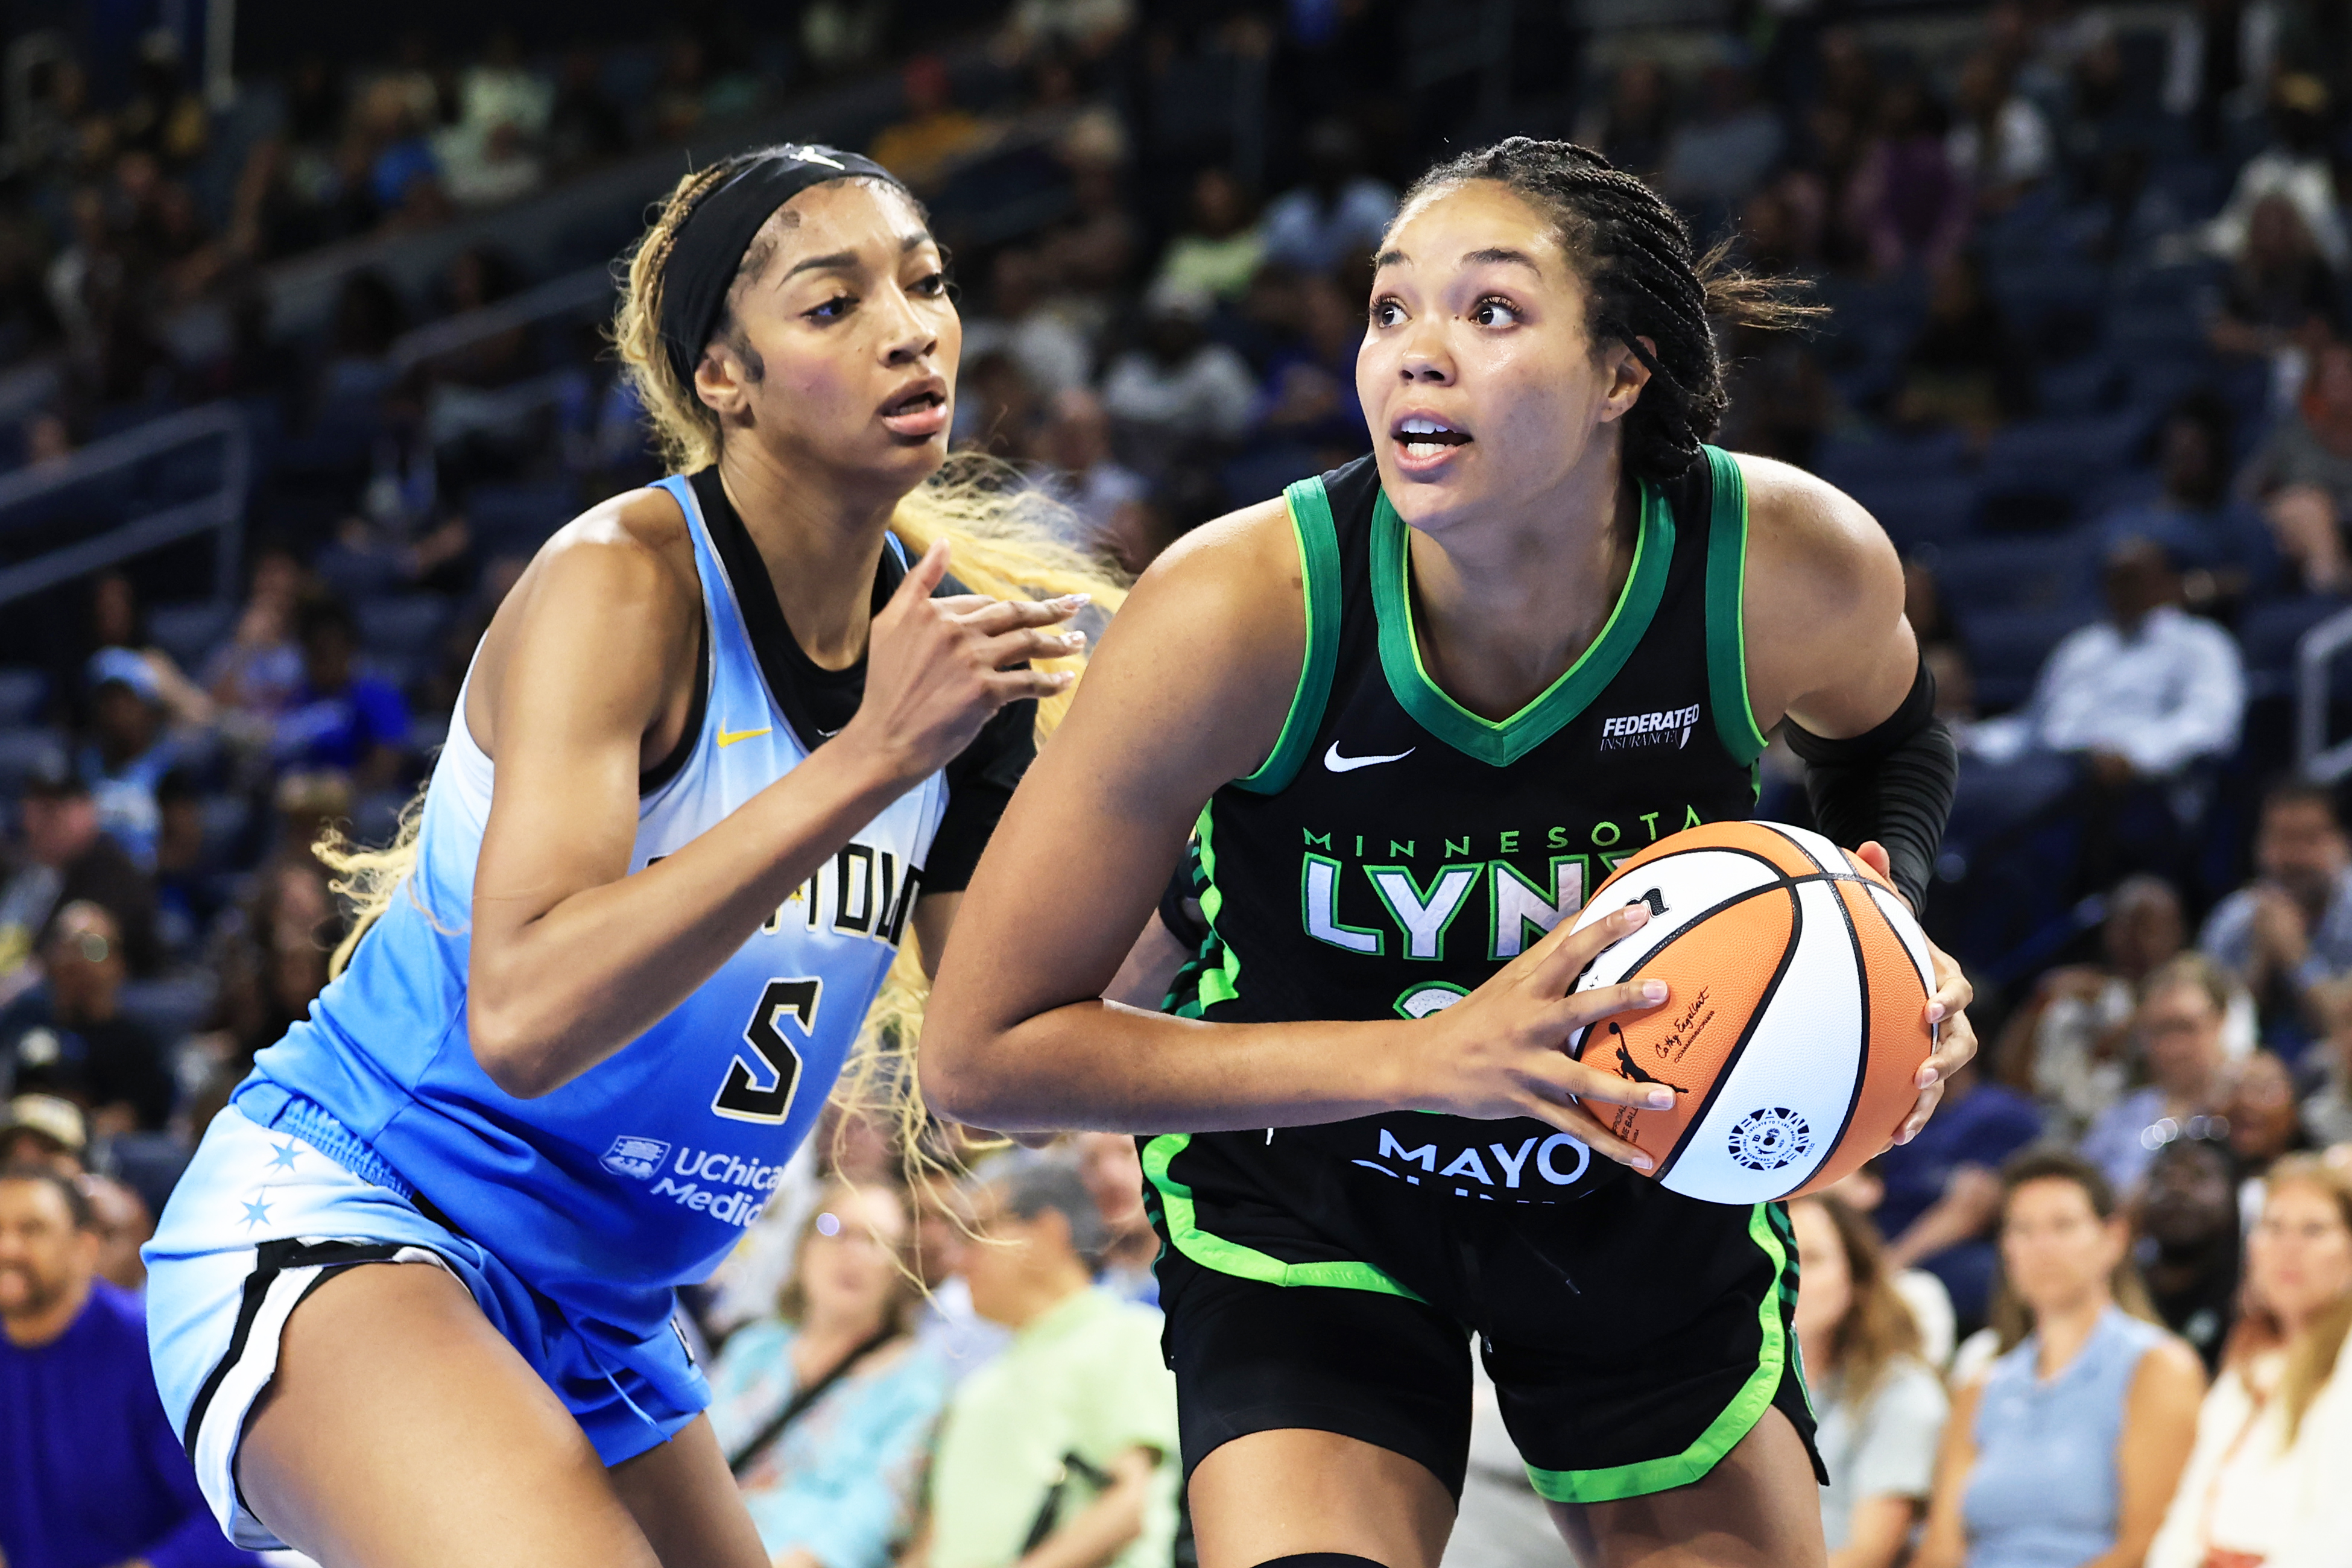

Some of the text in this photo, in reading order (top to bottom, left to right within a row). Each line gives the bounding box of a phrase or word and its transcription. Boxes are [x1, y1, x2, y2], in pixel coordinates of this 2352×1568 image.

[1600, 730, 1677, 751] INSURANCE
[1602, 703, 1699, 737] FEDERATED
[1303, 805, 1702, 858] MINNESOTA
[1301, 847, 1642, 961] LYN
[1674, 1010, 1715, 1063] COMMISSIONER
[1625, 1107, 1639, 1128] BALL
[674, 1147, 786, 1197] UChica
[1378, 1128, 1590, 1189] MAYO
[650, 1177, 764, 1227] Medic
